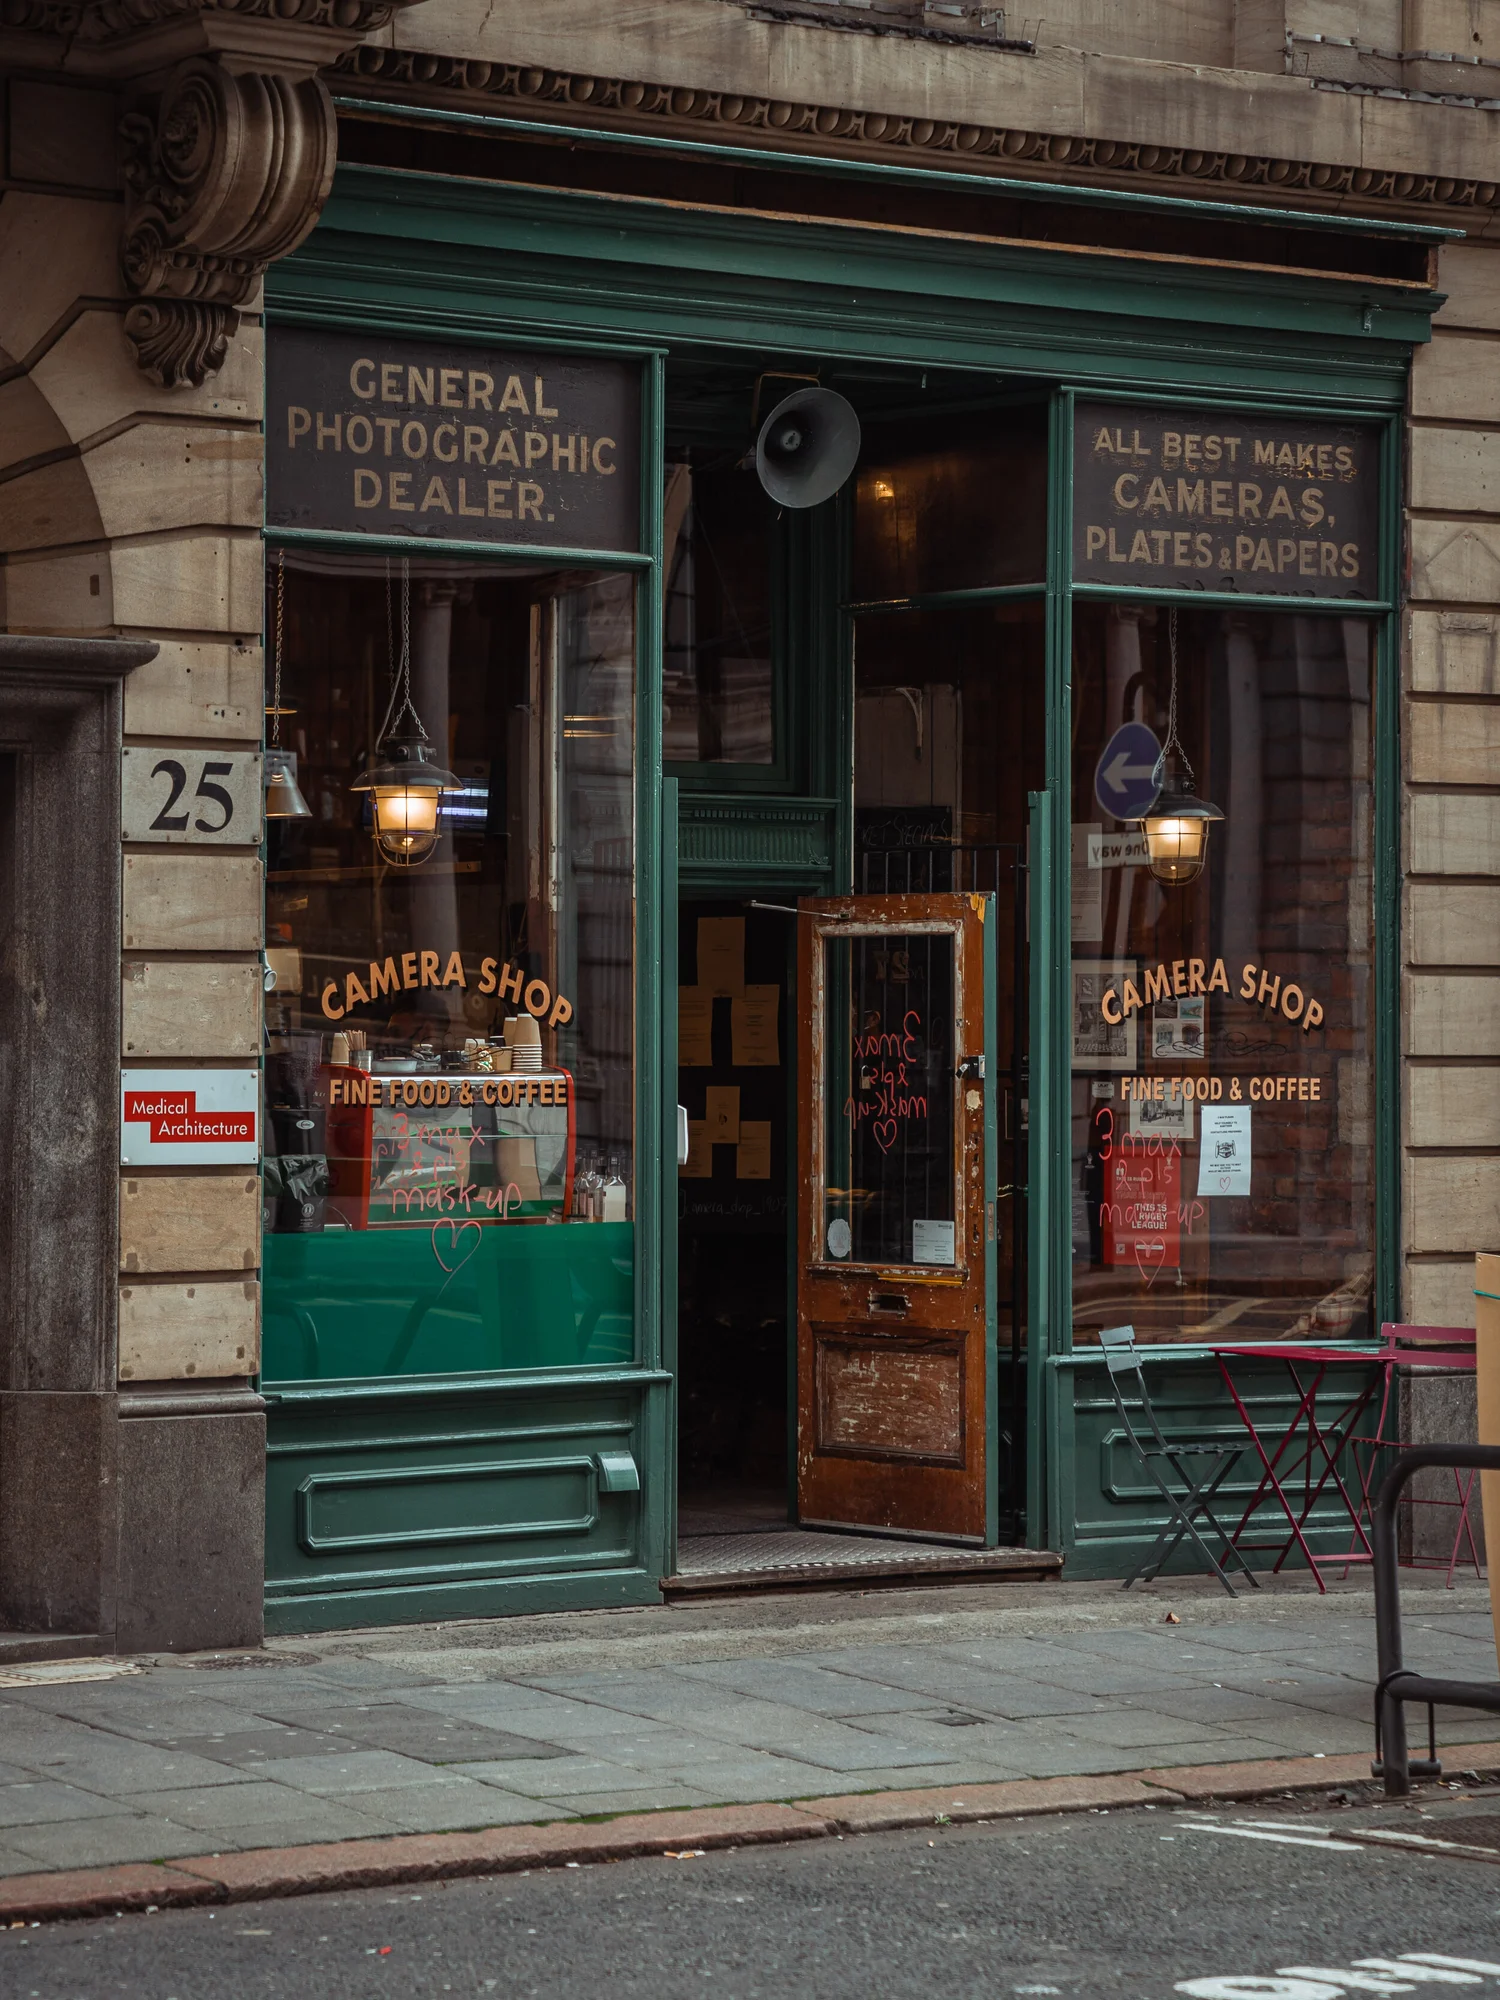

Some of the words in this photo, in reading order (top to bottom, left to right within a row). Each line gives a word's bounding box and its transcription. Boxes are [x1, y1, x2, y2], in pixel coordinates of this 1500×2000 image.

[350, 358, 559, 418] GENERAL
[288, 406, 617, 475] PHOTOGRAPHIC
[1094, 427, 1151, 455] ALL
[1164, 432, 1241, 462] BEST
[1254, 440, 1353, 471] MAKES
[353, 469, 556, 523] DEALER.
[1114, 473, 1336, 527] CAMERAS,
[1086, 525, 1213, 569] PLATES
[1218, 547, 1232, 571] &
[1235, 536, 1360, 578] PAPERS
[149, 759, 234, 832] 25
[320, 950, 467, 1022] CAMERA
[477, 957, 573, 1029] SHOP
[1101, 958, 1230, 1025] CAMERA
[1239, 964, 1325, 1031] SHOP
[132, 1099, 188, 1116] Medical
[329, 1079, 382, 1105] FINE
[389, 1079, 451, 1105] FOOD
[459, 1079, 475, 1105] &
[482, 1079, 568, 1105] COFFEE
[1121, 1077, 1164, 1101] FINE
[1171, 1077, 1223, 1101] FOOD
[1230, 1077, 1242, 1101] &
[1249, 1077, 1321, 1101] COFFEE
[158, 1119, 248, 1137] Architecture
[415, 1122, 485, 1147] max
[1095, 1107, 1115, 1160] 3
[1121, 1130, 1182, 1160] max
[392, 1176, 523, 1220] mask-up
[1132, 1221, 1167, 1230] LEAGUE!
